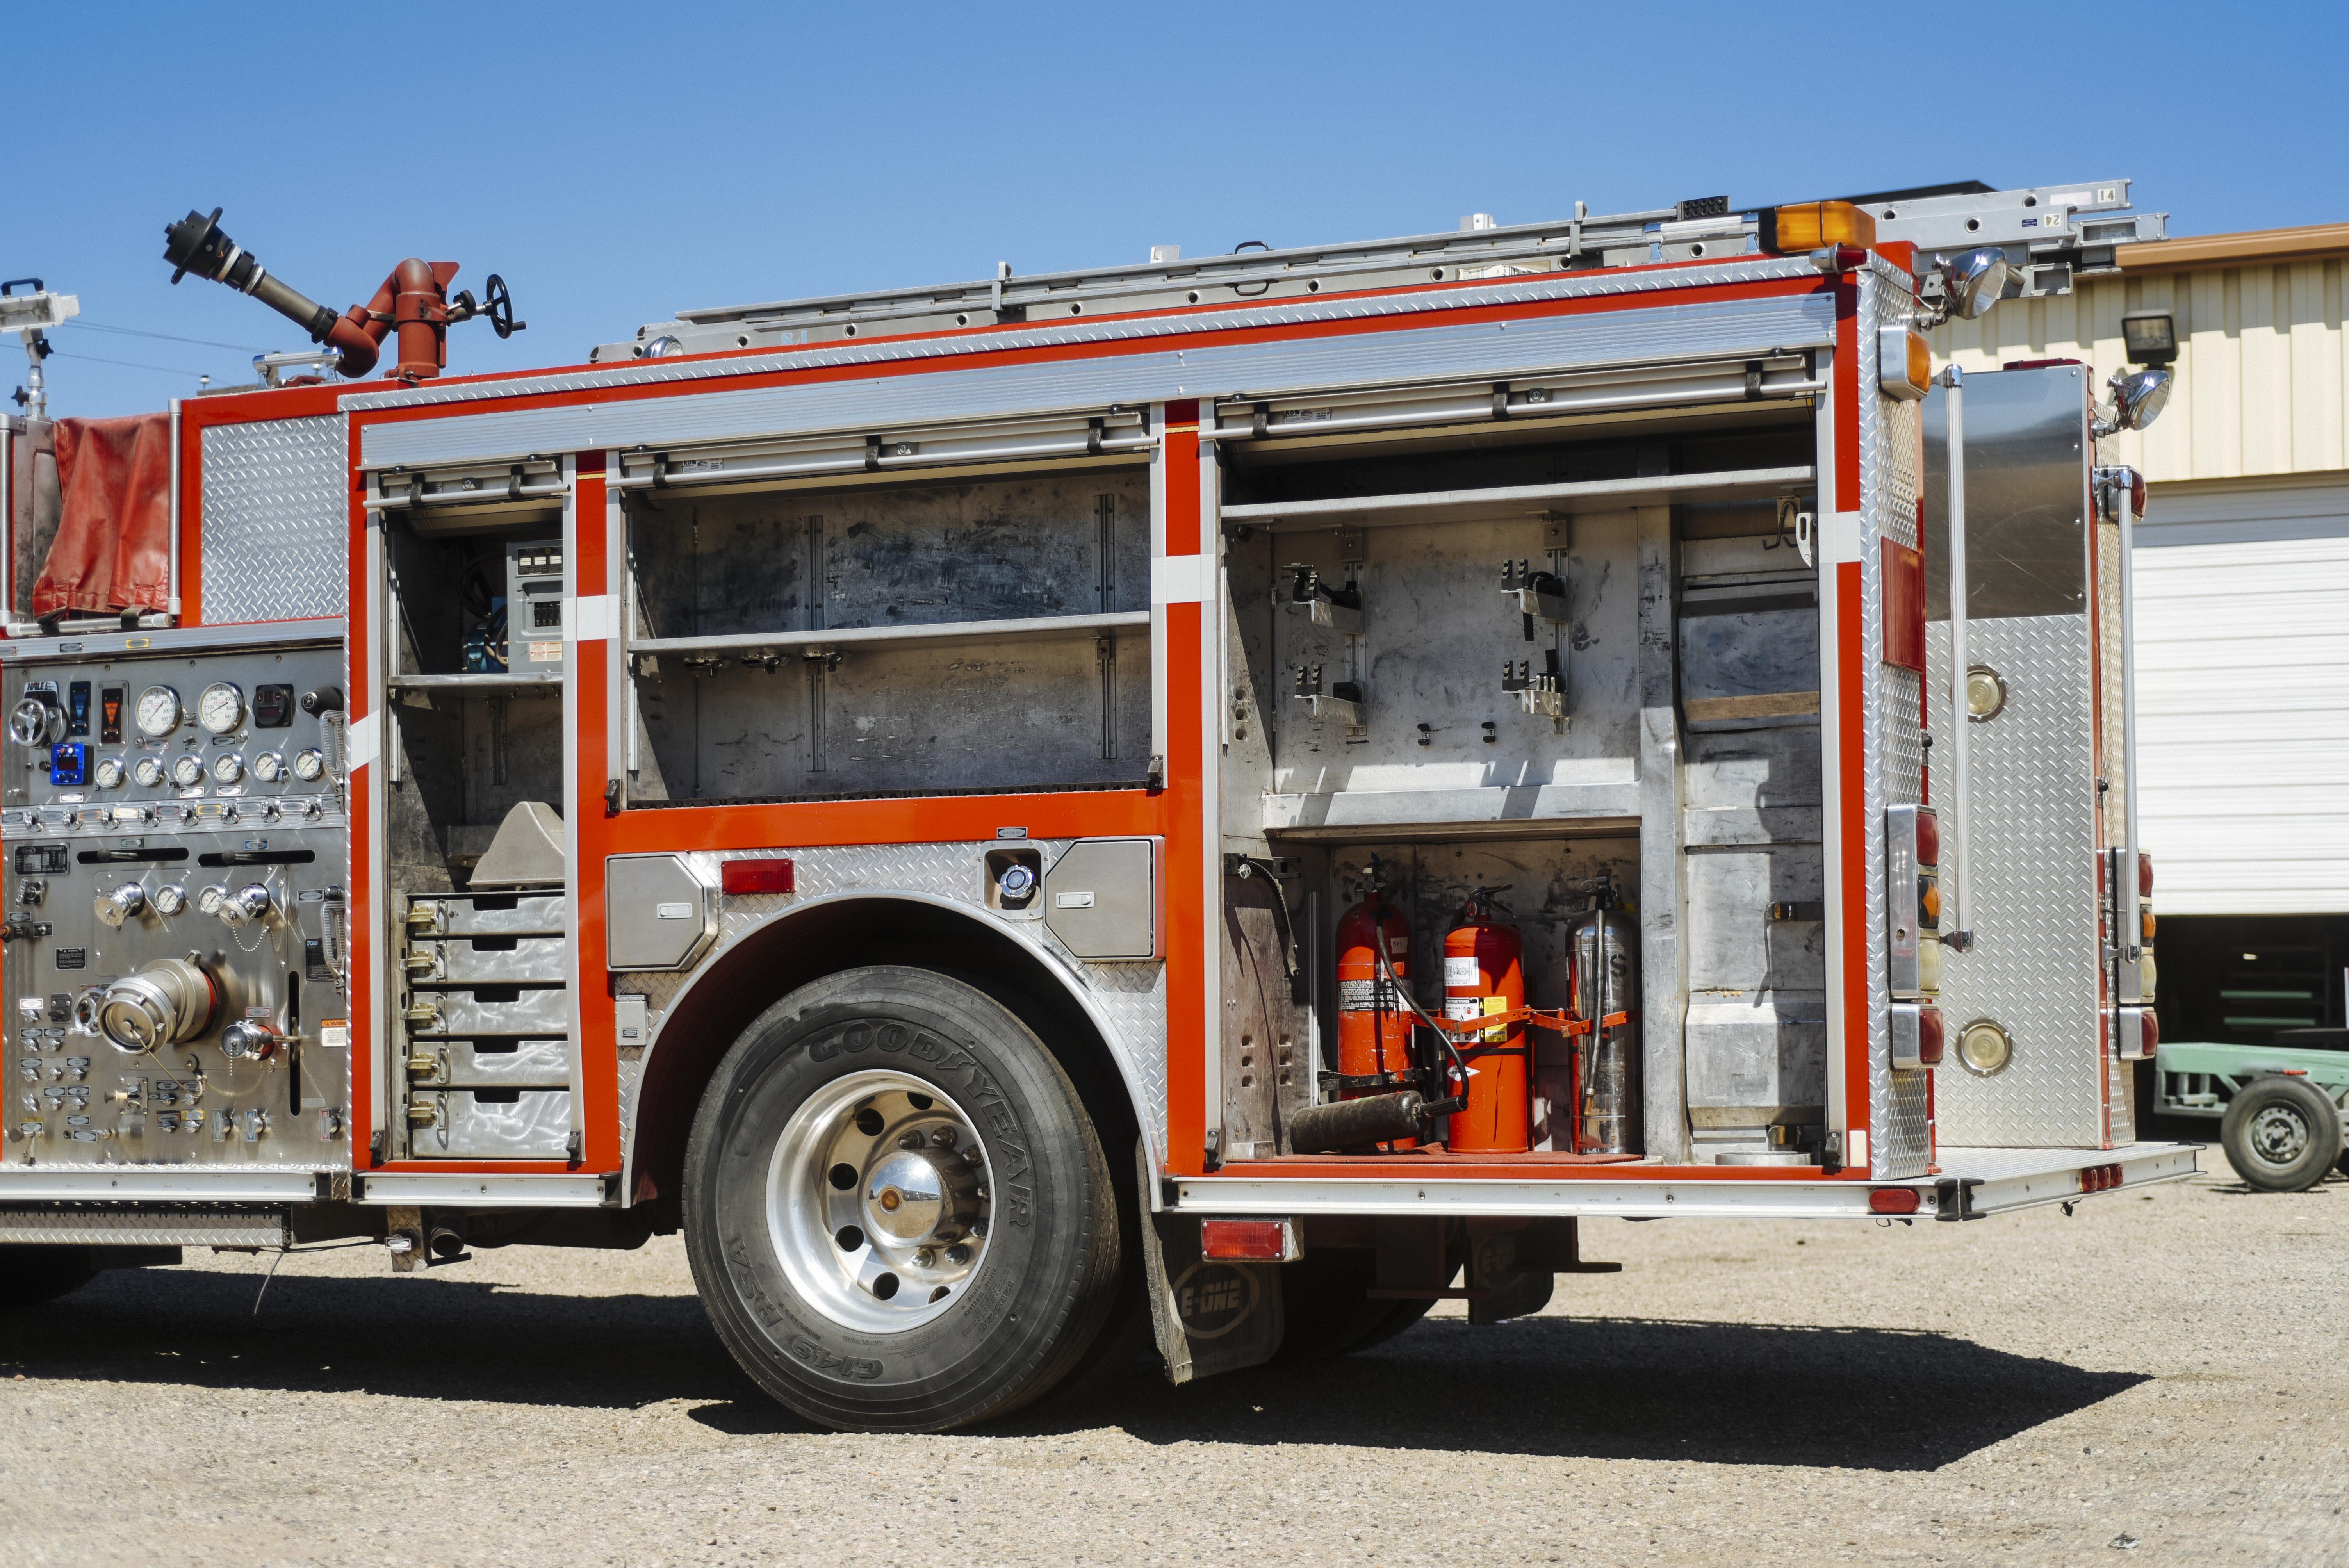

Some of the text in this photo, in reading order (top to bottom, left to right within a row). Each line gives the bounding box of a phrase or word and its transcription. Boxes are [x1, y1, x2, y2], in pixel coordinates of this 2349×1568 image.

[2100, 190, 2114, 201] 14
[2046, 215, 2060, 226] 24
[1610, 953, 1627, 978] S
[808, 1023, 1033, 1228] GOODYEAR
[727, 1236, 783, 1328] RSA
